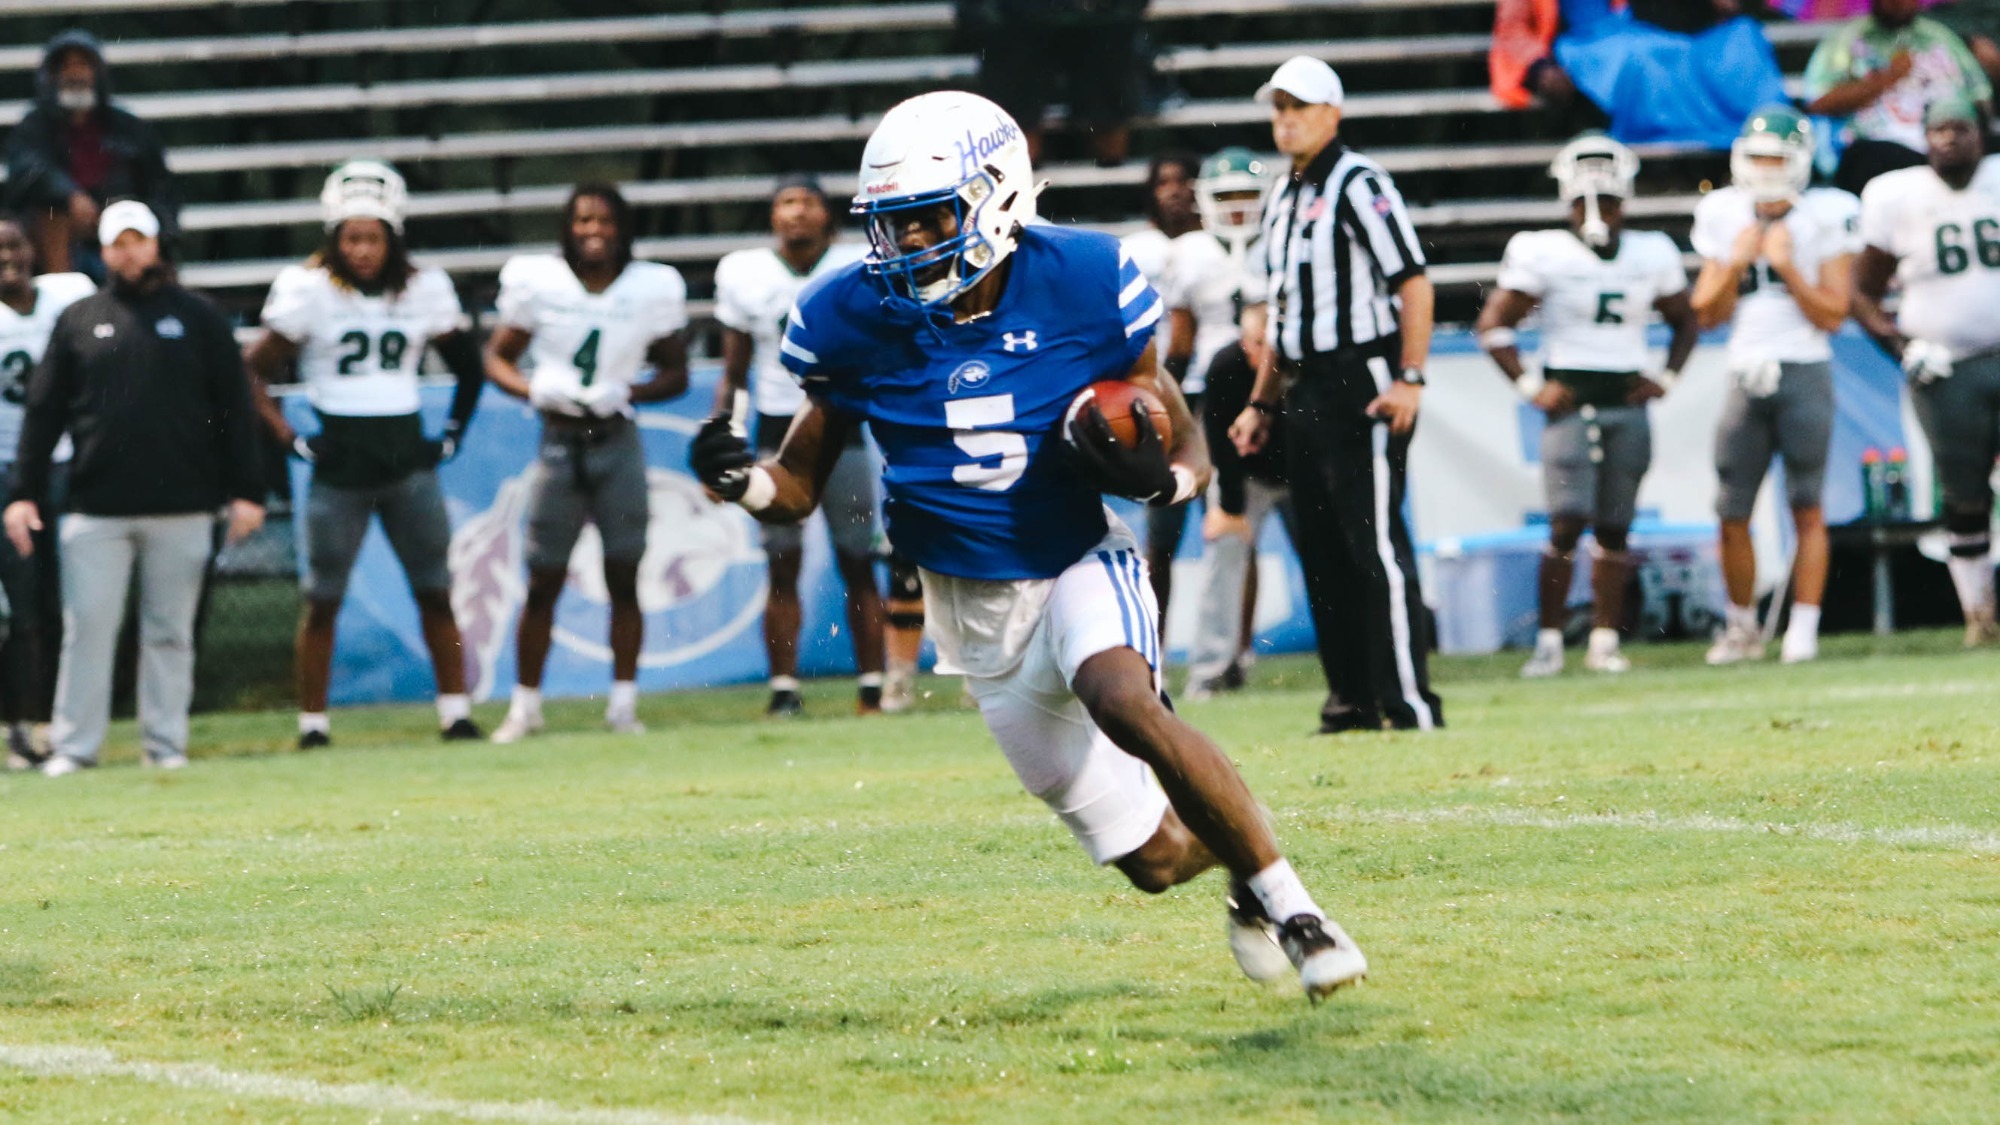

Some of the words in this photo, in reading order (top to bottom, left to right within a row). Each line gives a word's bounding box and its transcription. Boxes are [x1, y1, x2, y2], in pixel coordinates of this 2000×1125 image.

[1936, 218, 2000, 274] 66
[572, 329, 601, 387] 4
[944, 394, 1028, 492] 5
